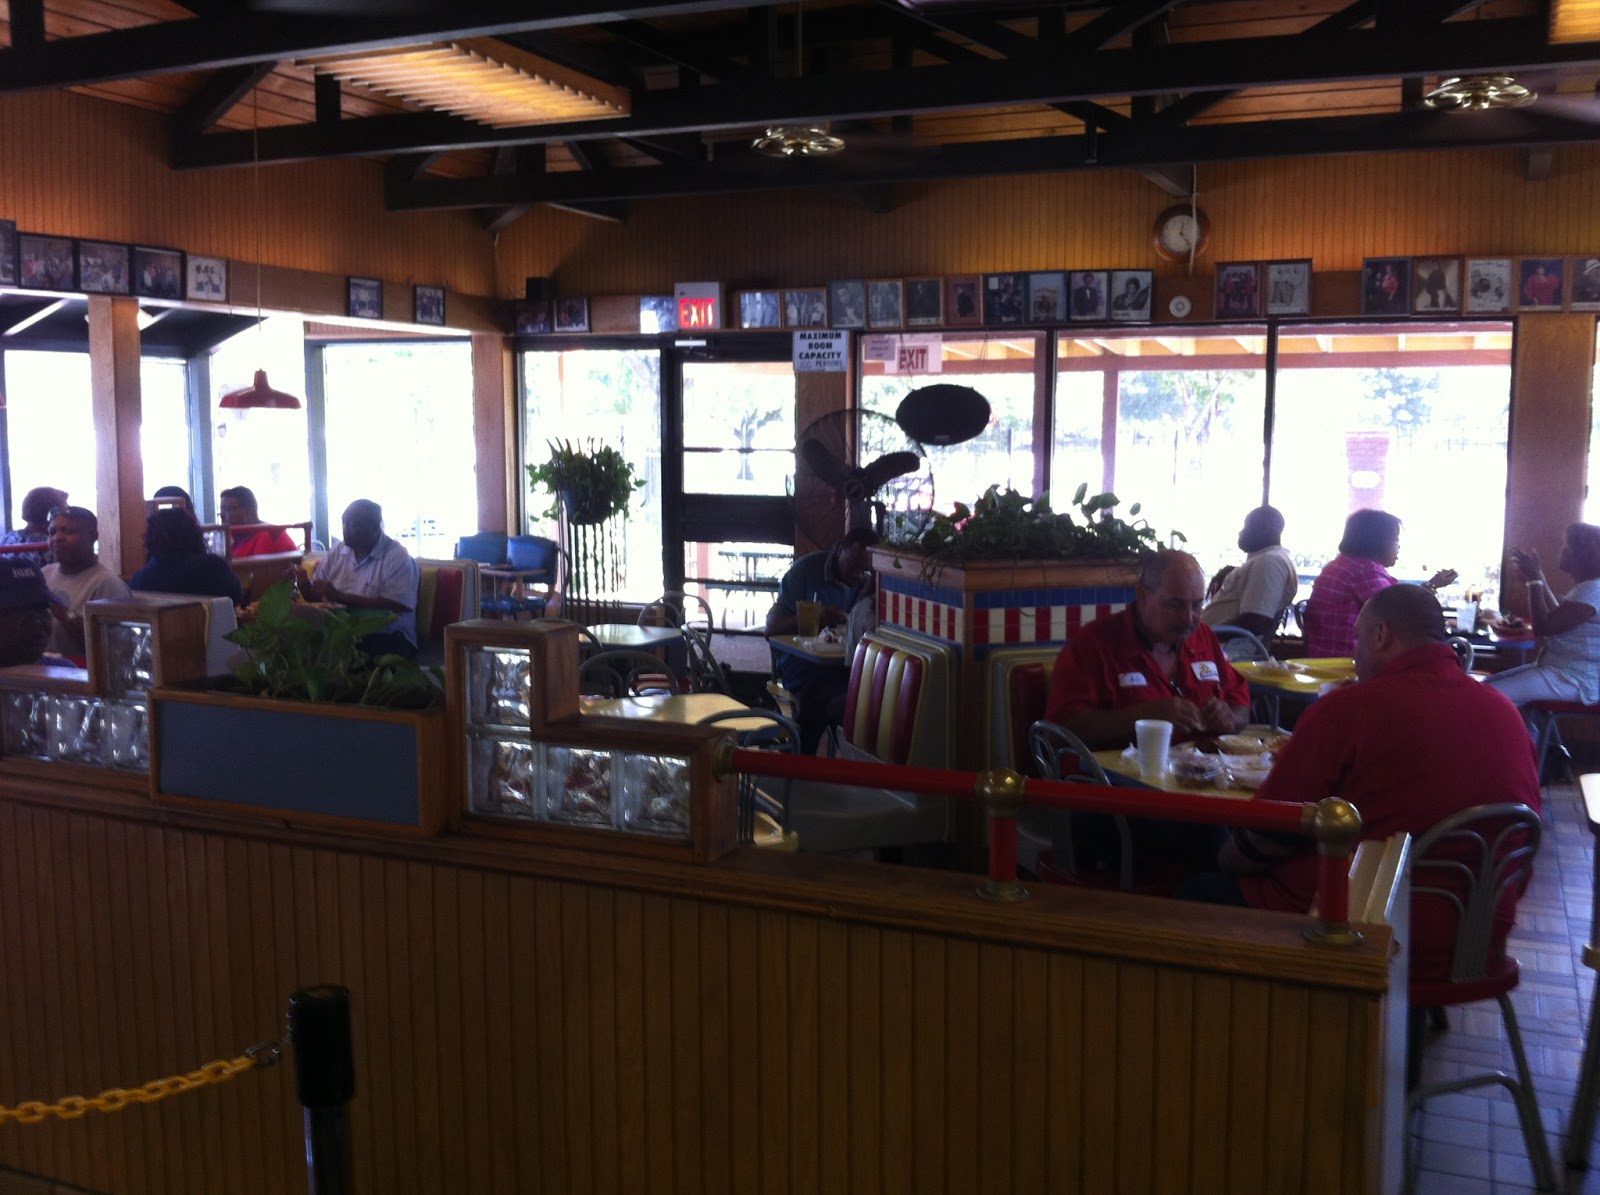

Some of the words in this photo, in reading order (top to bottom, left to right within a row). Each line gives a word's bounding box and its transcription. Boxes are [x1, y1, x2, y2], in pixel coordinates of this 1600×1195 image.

[679, 298, 715, 328] EXIT
[800, 332, 842, 340] MAXIMUM
[808, 342, 833, 350] ROOM
[798, 352, 842, 360] CAPACITY
[899, 348, 927, 369] EXIT
